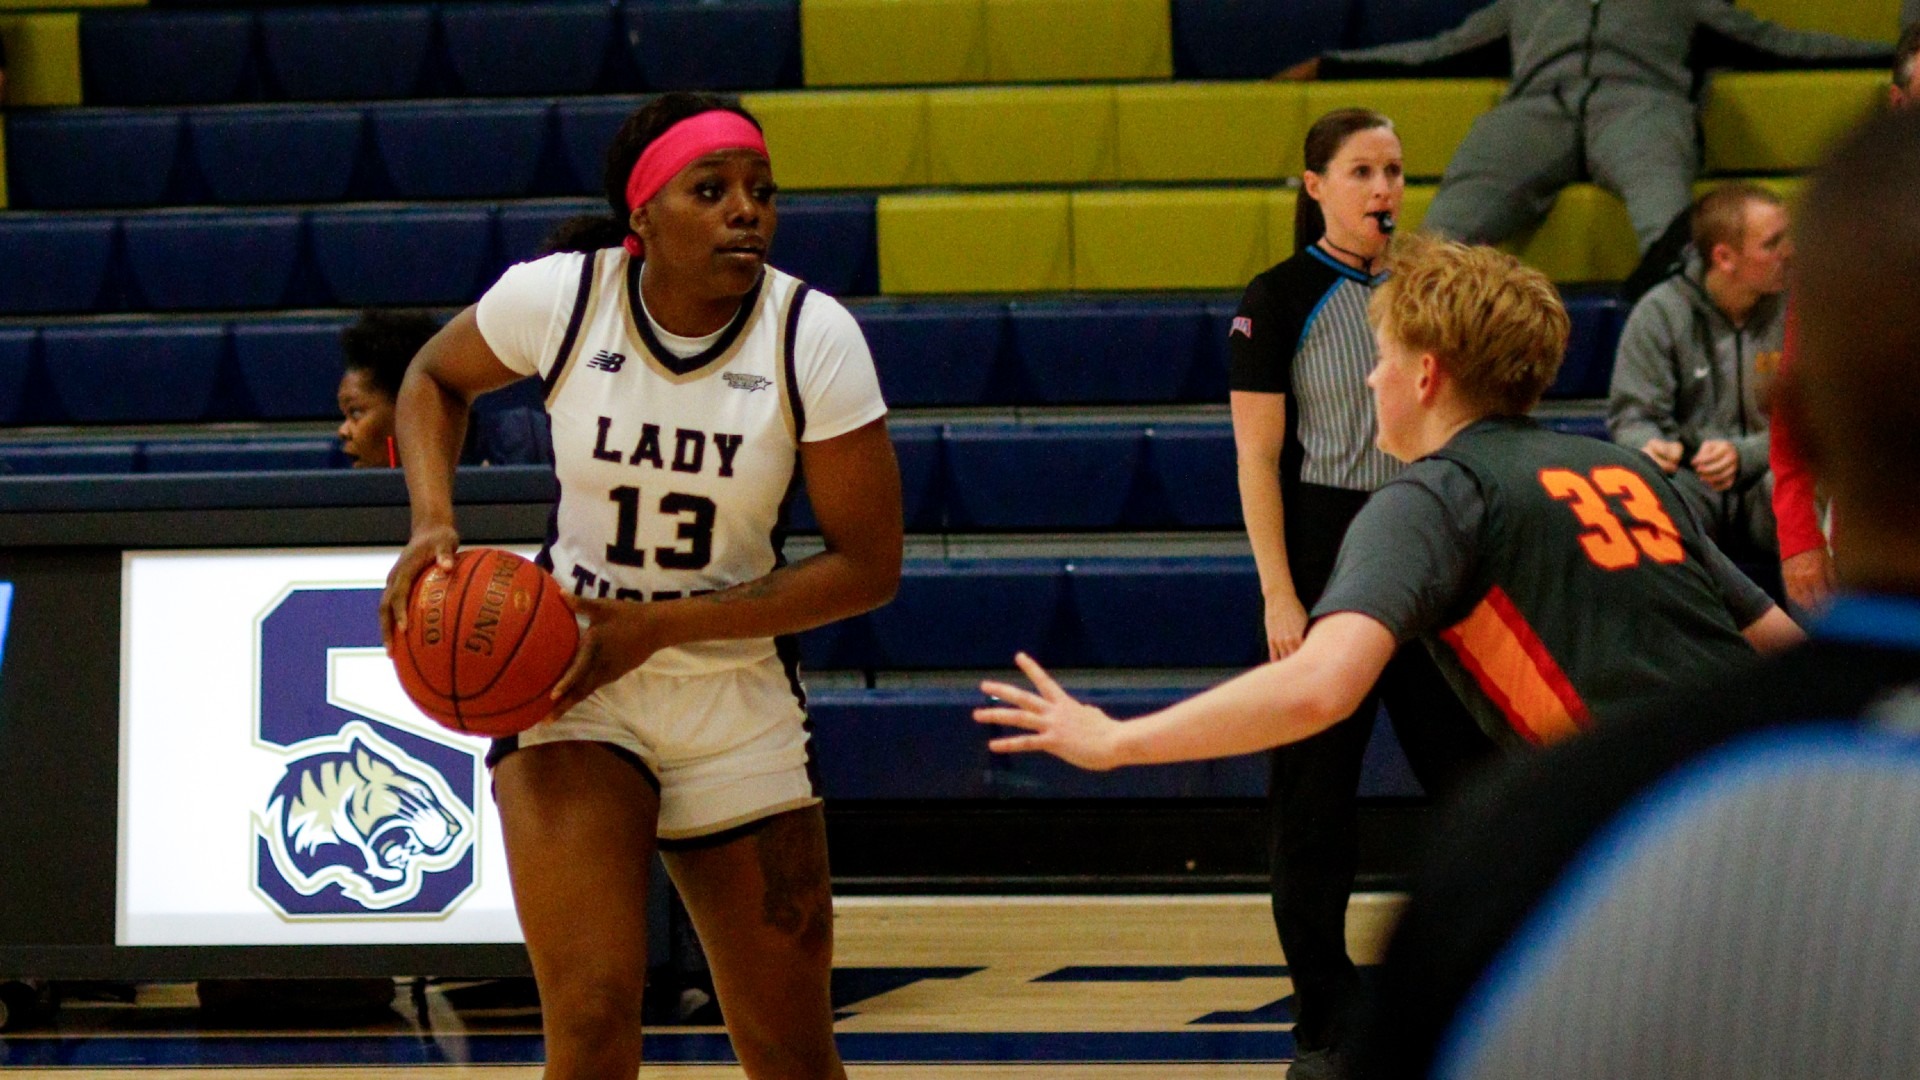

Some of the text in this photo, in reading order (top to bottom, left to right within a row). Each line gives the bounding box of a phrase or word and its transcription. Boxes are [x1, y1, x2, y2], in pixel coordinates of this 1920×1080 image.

[592, 415, 744, 478] LADY
[605, 485, 717, 570] 13
[1538, 464, 1685, 571] 33
[465, 552, 521, 657] PALDING
